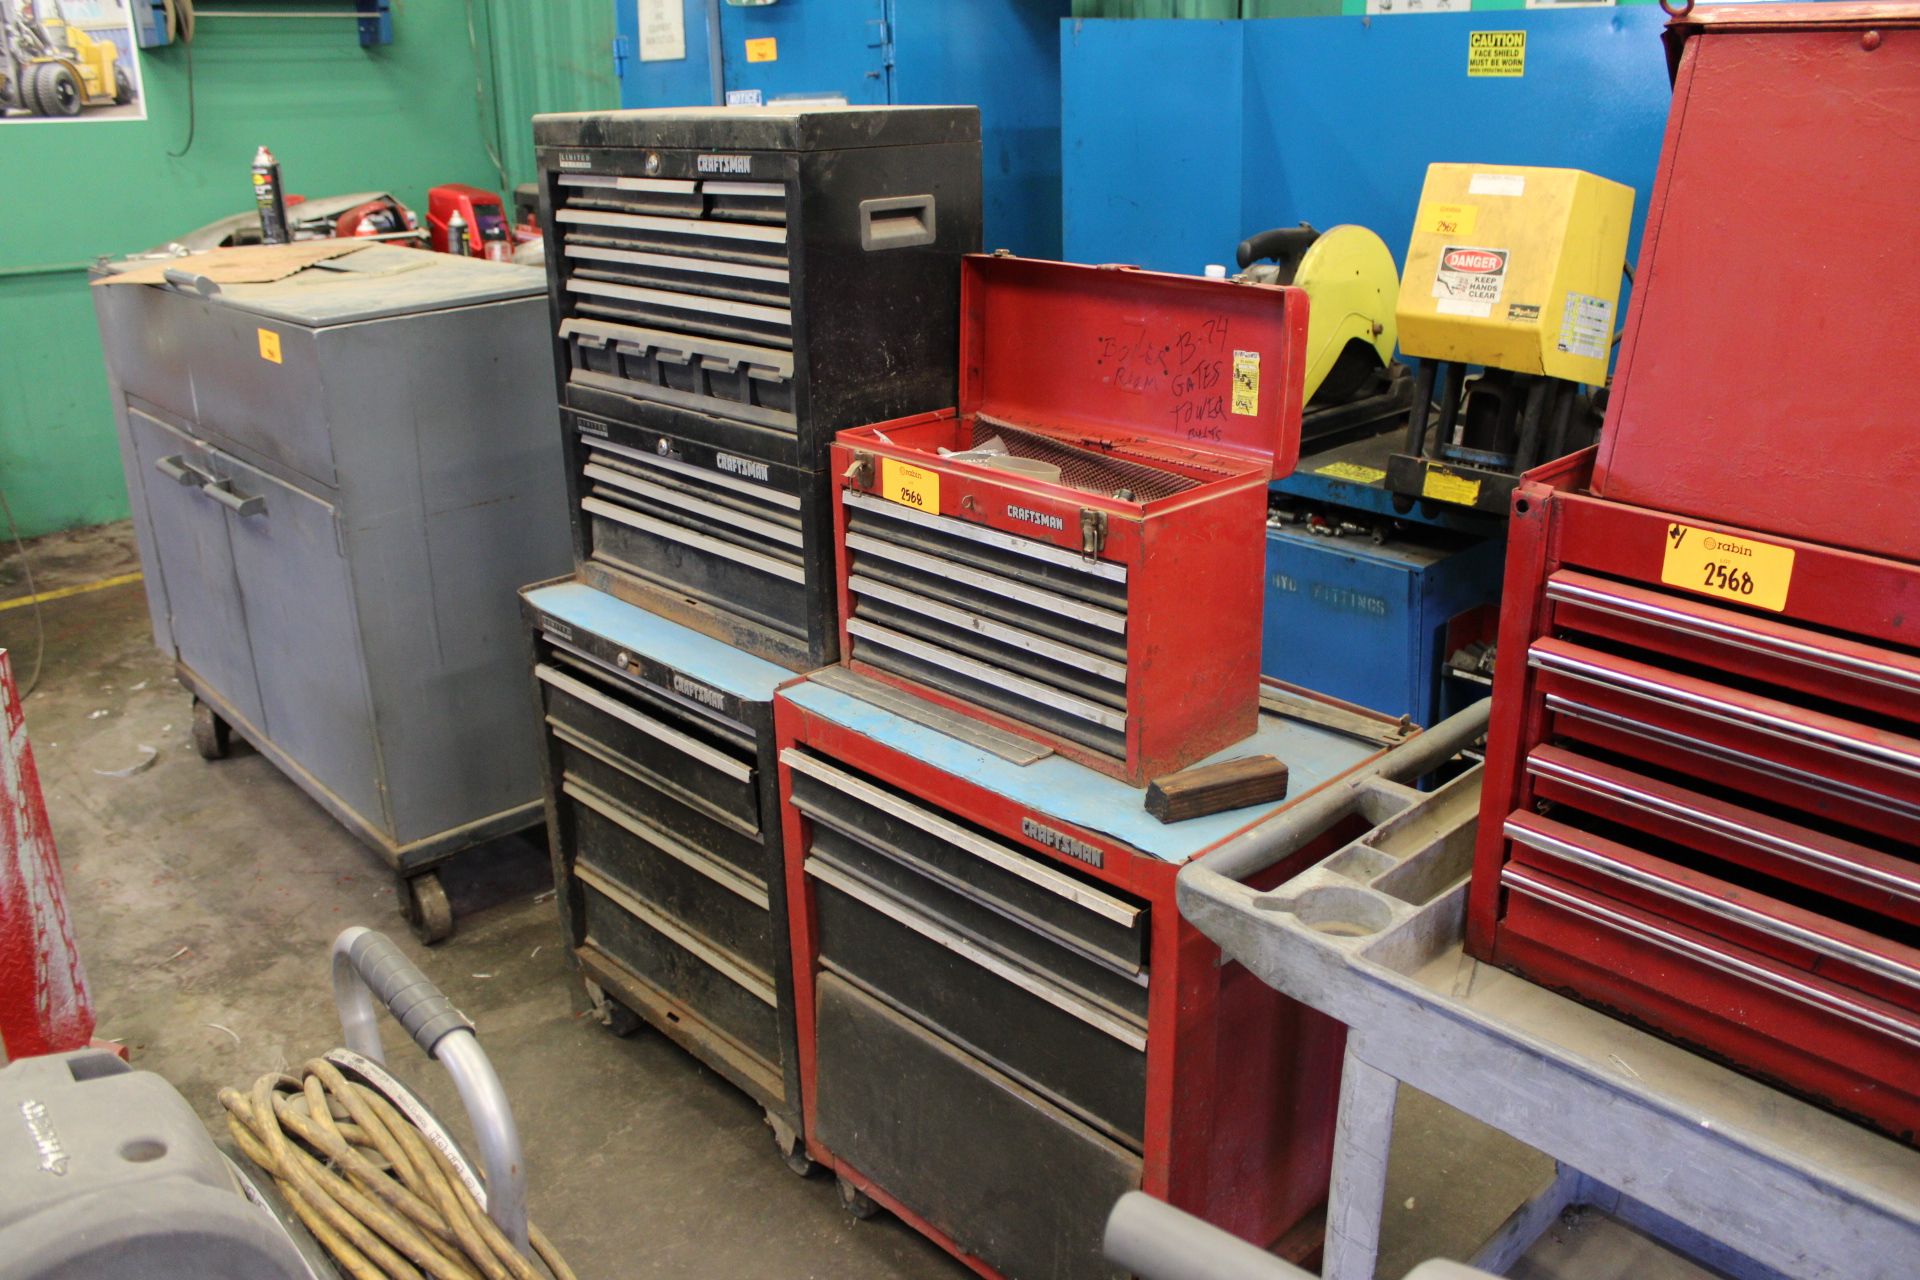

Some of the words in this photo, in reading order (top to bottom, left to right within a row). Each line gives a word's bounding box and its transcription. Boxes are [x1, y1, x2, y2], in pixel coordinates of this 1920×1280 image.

[1472, 33, 1523, 47] CAUTION
[1475, 49, 1491, 57] FACE
[1494, 49, 1520, 57] SHIELD
[697, 154, 752, 173] CRAFTSMAN
[1450, 254, 1497, 269] DANGER
[1469, 284, 1498, 292] HANDS
[1475, 276, 1497, 284] KEEP
[1468, 291, 1496, 299] CLEAR
[1171, 359, 1223, 397] GATES
[1169, 396, 1228, 434] TOWER
[716, 452, 769, 481] CRAFTSMAN
[901, 487, 923, 506] 2568
[1008, 504, 1063, 530] CRAFTSMAN
[1716, 540, 1753, 557] rabin
[1703, 562, 1755, 595] 2568
[1311, 583, 1386, 616] FITTINGS
[673, 673, 725, 711] CRAFTSMAN
[1022, 816, 1104, 869] CRAFTSMAN
